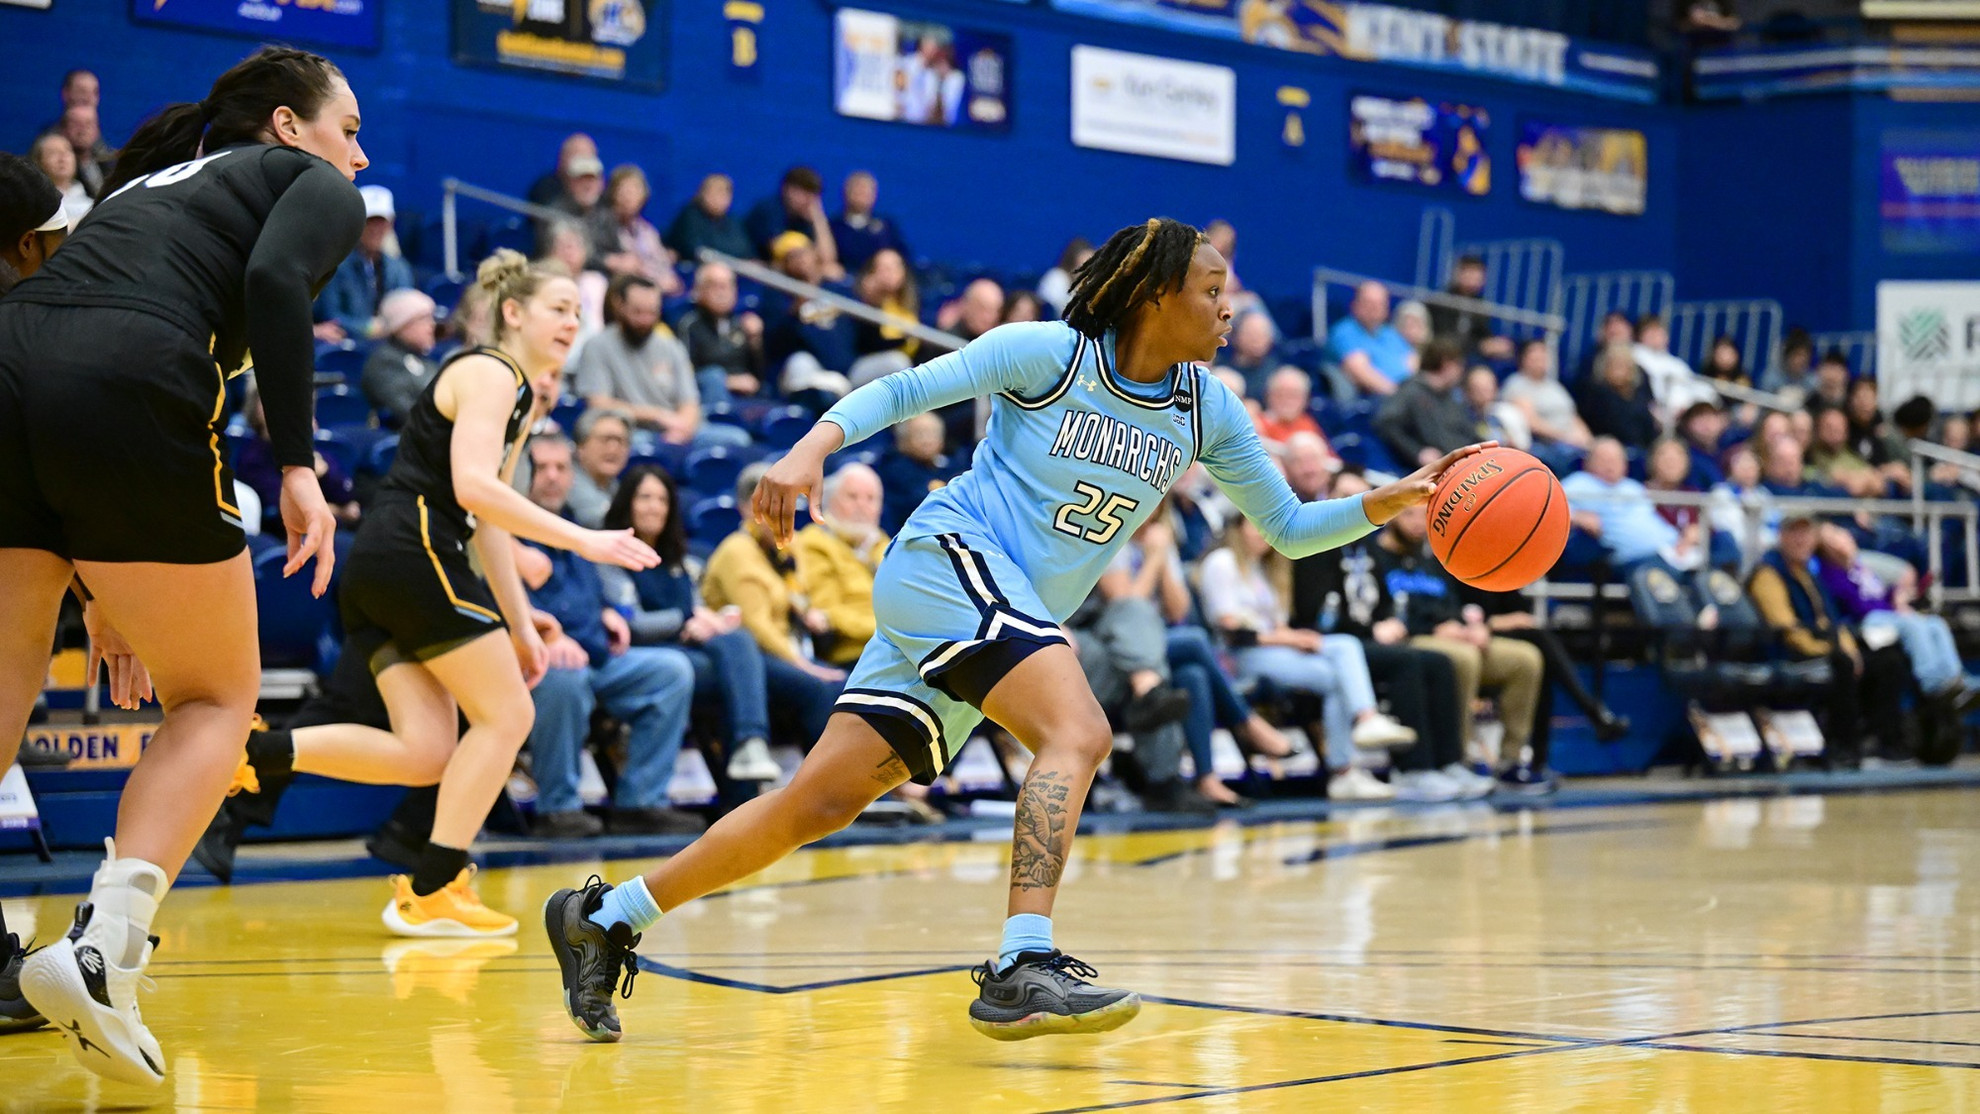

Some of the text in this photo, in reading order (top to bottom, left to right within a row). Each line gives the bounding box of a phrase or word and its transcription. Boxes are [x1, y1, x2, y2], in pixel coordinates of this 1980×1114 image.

[1348, 3, 1569, 85] KENT STATE
[1175, 394, 1192, 405] NMP
[1050, 410, 1182, 494] MONARCHS
[1053, 480, 1139, 544] 25
[1432, 459, 1504, 538] SPALDING
